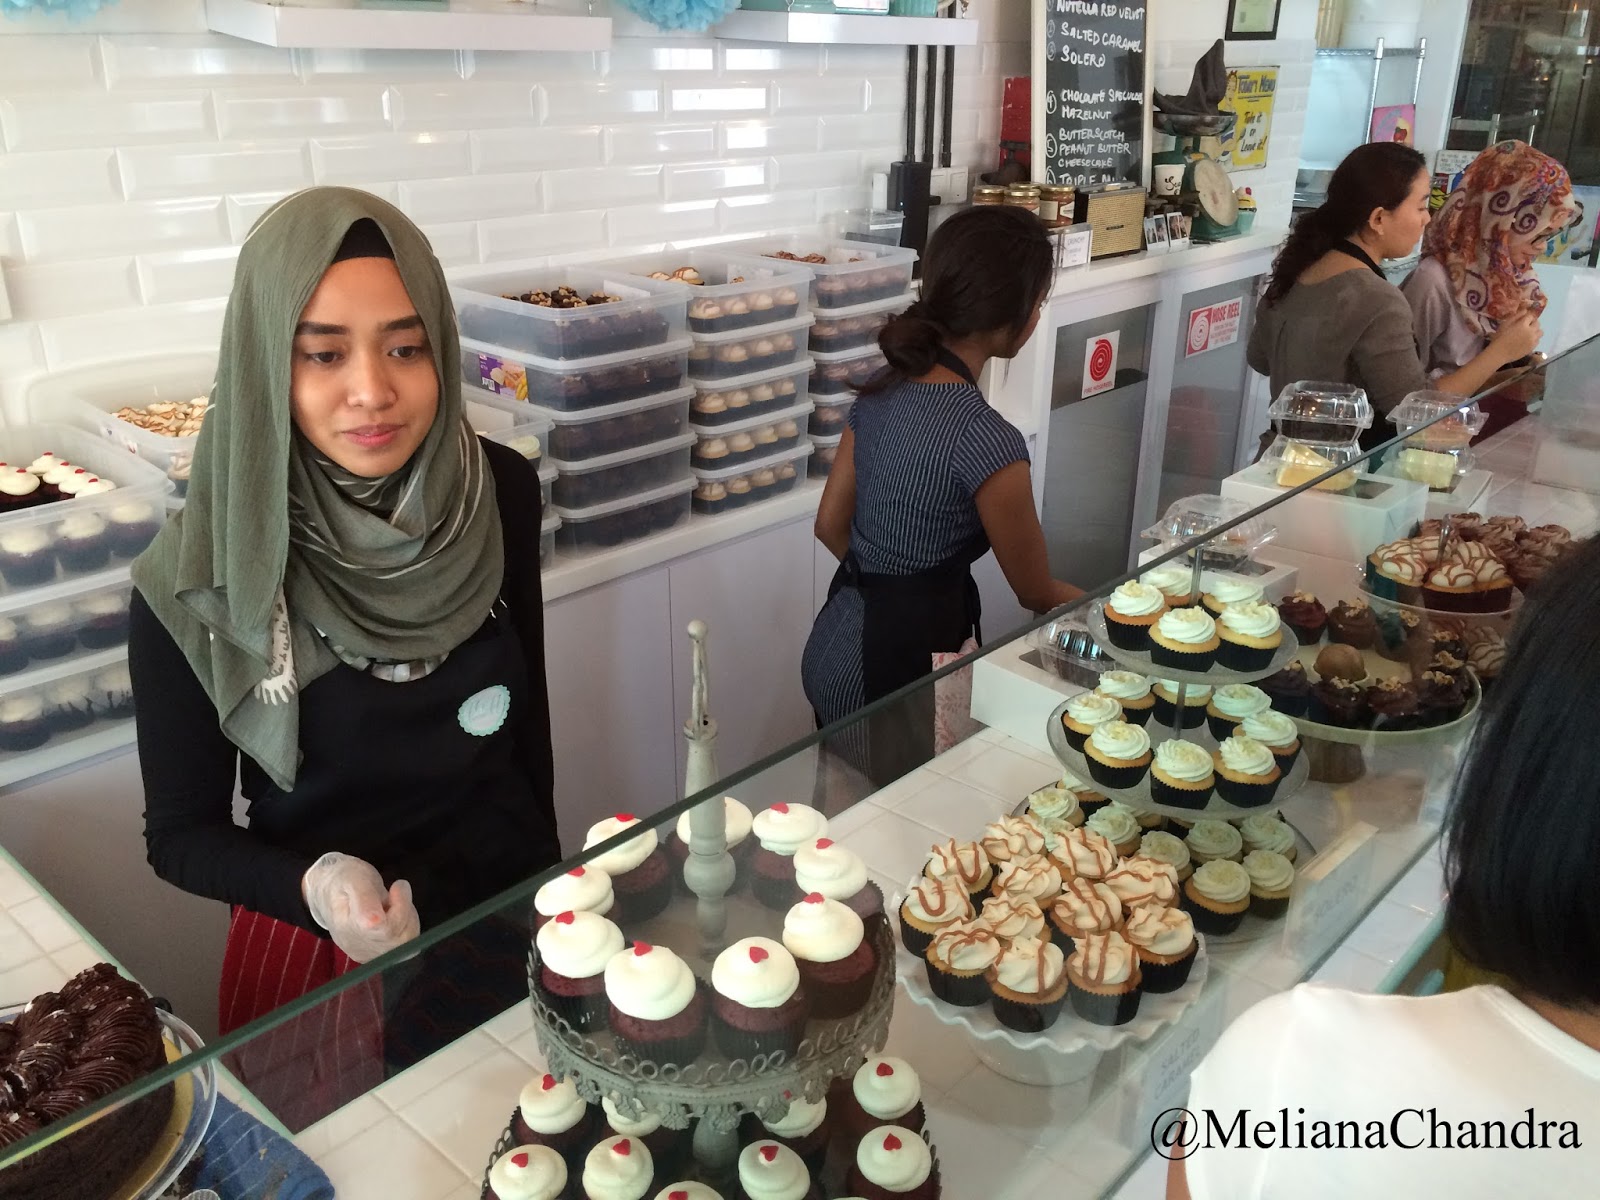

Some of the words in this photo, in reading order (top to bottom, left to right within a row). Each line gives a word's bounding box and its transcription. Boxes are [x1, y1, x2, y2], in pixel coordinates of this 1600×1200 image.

[1056, 0, 1099, 16] NUTELLA
[1100, 3, 1117, 17] RED
[1060, 21, 1100, 46] SALTED
[1101, 32, 1143, 53] CARAMEL
[1060, 44, 1106, 68] SOLERO
[1061, 88, 1106, 104] CHOCOLATE
[1061, 105, 1112, 121] HAZELNUT
[1059, 127, 1125, 142] BUTTERSCOTCH
[1059, 143, 1095, 156] PEANUT
[1097, 142, 1131, 155] BUTTER
[1057, 157, 1114, 168] CHEESECAKE
[1059, 172, 1097, 185] TRIPLE
[1211, 305, 1227, 324] HOSE
[1227, 301, 1240, 319] REEL
